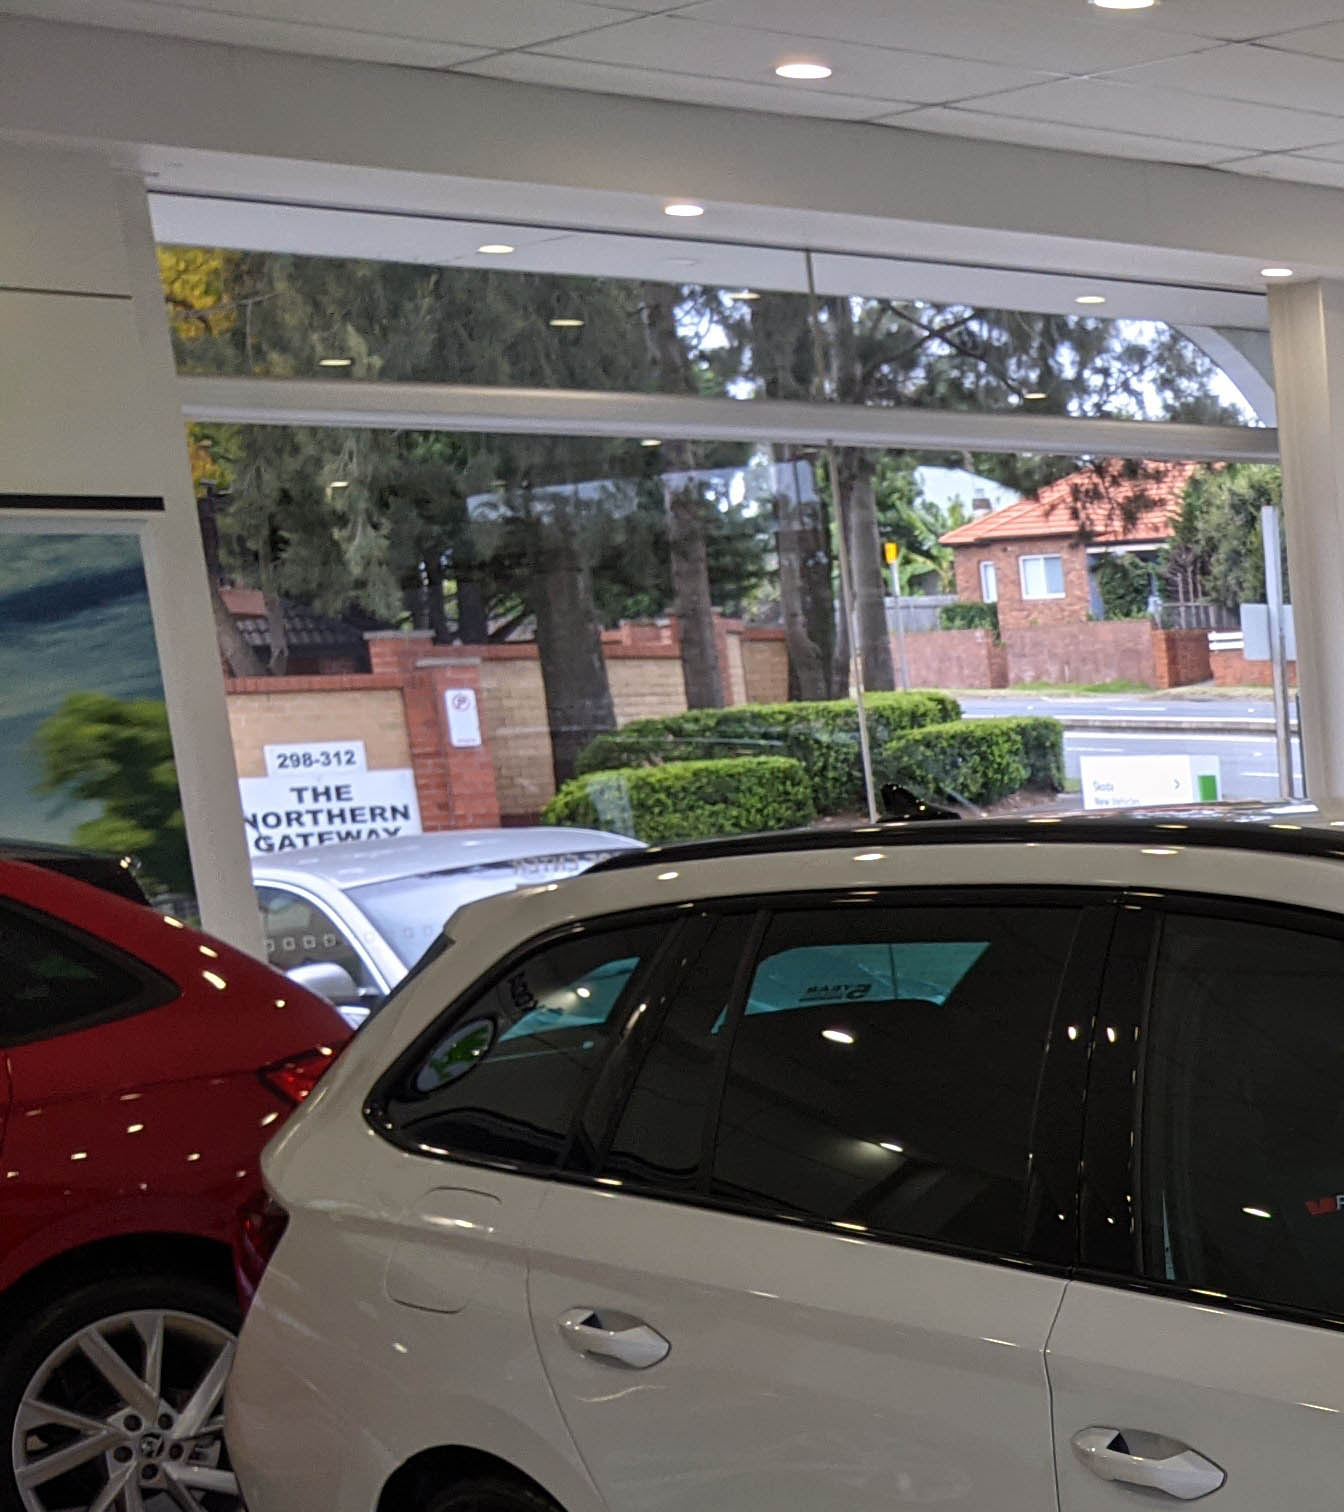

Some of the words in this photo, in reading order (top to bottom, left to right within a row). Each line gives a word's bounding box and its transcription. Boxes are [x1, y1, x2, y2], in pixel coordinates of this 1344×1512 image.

[276, 750, 357, 769] 298-312
[289, 784, 354, 804] THE
[244, 804, 411, 830] NORTHERN
